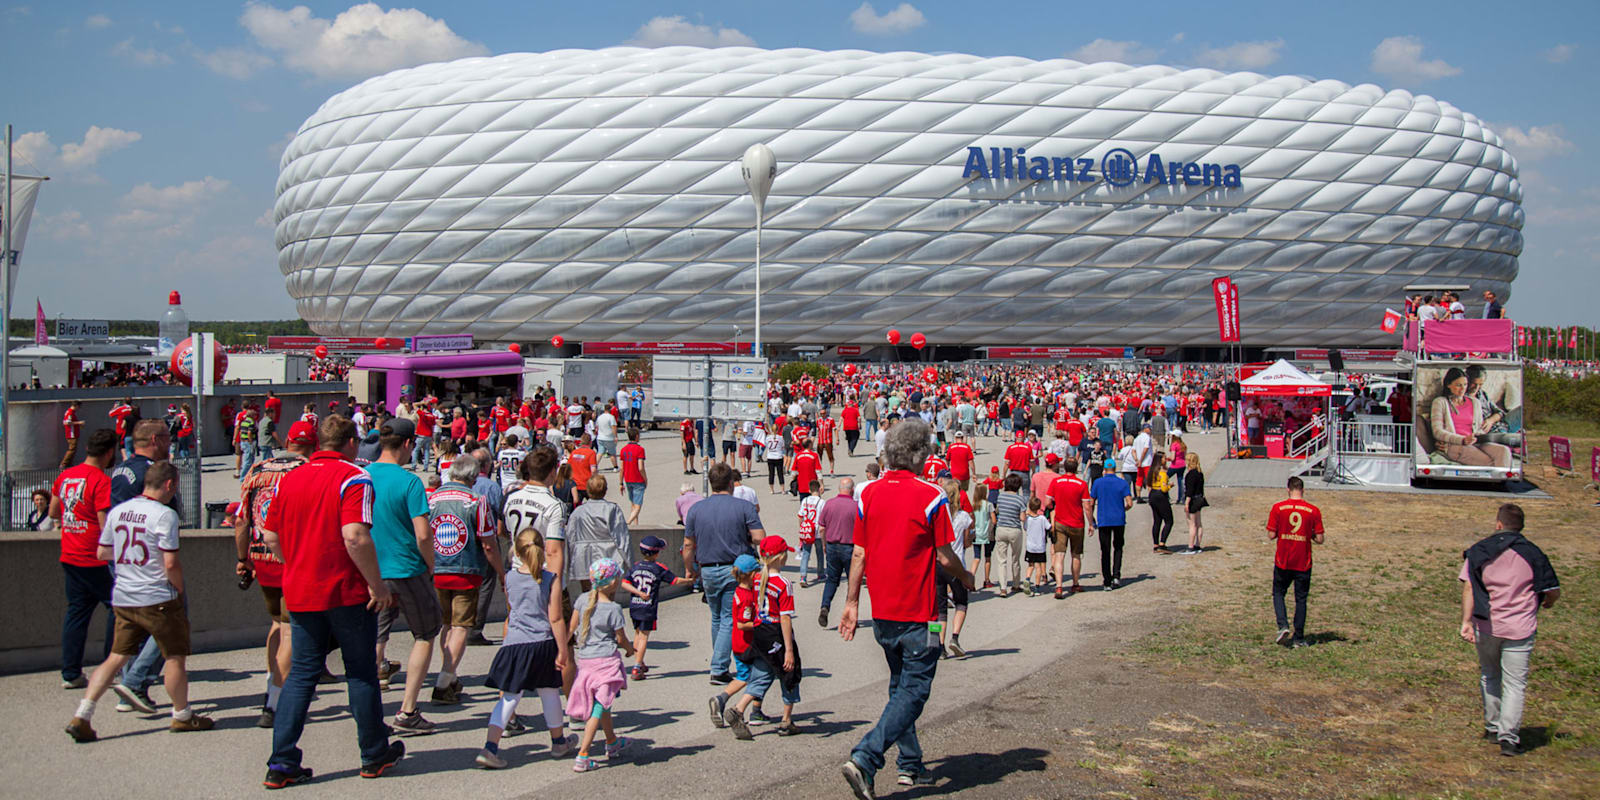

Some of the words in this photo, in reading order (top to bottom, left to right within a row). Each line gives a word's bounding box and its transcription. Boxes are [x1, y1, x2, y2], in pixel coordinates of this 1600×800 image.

[962, 146, 1096, 182] Allianz
[1143, 153, 1242, 187] Arena
[59, 322, 78, 335] Bier
[81, 322, 108, 335] Arena
[502, 457, 519, 471] 20
[928, 463, 936, 478] 4
[119, 510, 147, 523] MÜLLER
[431, 519, 441, 529] FC
[440, 514, 467, 535] BAYERN
[509, 509, 540, 536] 27
[1289, 511, 1303, 534] 9
[114, 524, 150, 566] 25
